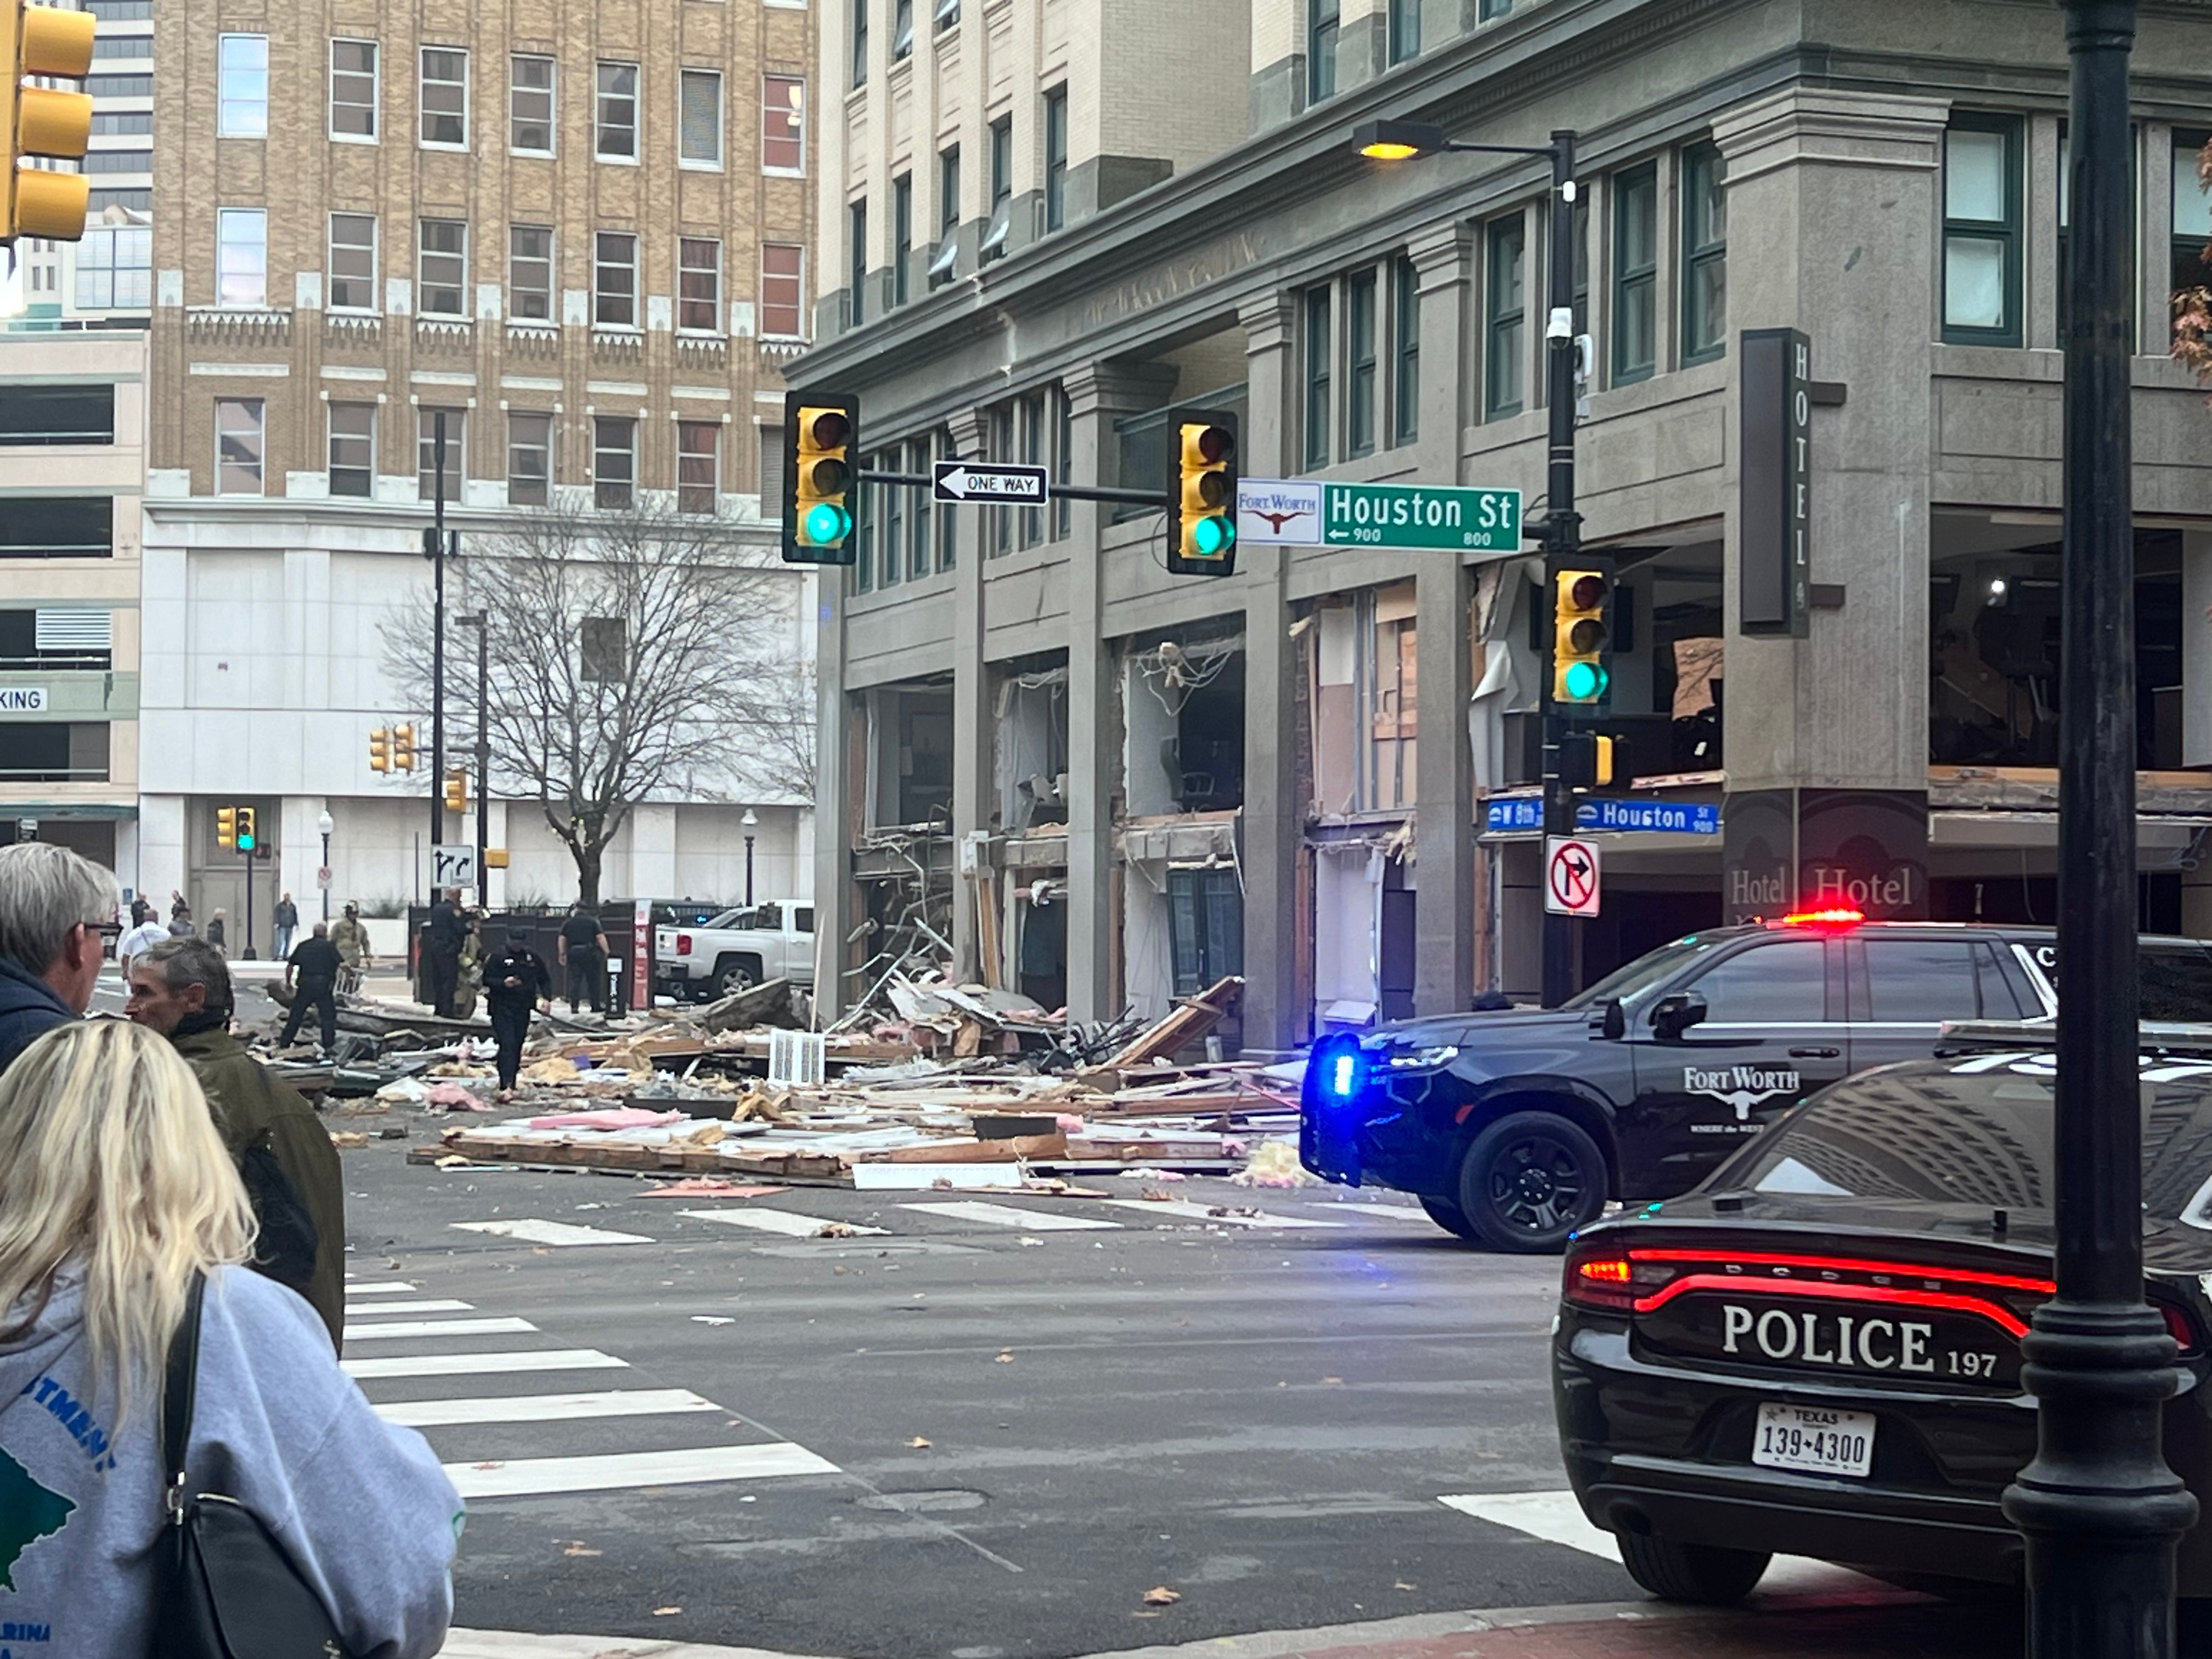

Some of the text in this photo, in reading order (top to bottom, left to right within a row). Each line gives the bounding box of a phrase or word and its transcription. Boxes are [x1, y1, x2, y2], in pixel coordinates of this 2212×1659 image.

[968, 476, 1034, 492] ONE WAY
[1239, 493, 1316, 510] FORT WORTH
[1331, 488, 1511, 528] Houston St
[1353, 528, 1381, 541] 900
[1463, 532, 1491, 546] 800
[1603, 803, 1685, 828] Houston
[1731, 867, 1787, 904] Hotel
[1815, 867, 1912, 904] Hotel
[1684, 1066, 1800, 1089] FORT WORTH
[1723, 1305, 1997, 1377] POLICE 197
[1795, 1409, 1838, 1424] TEXAS
